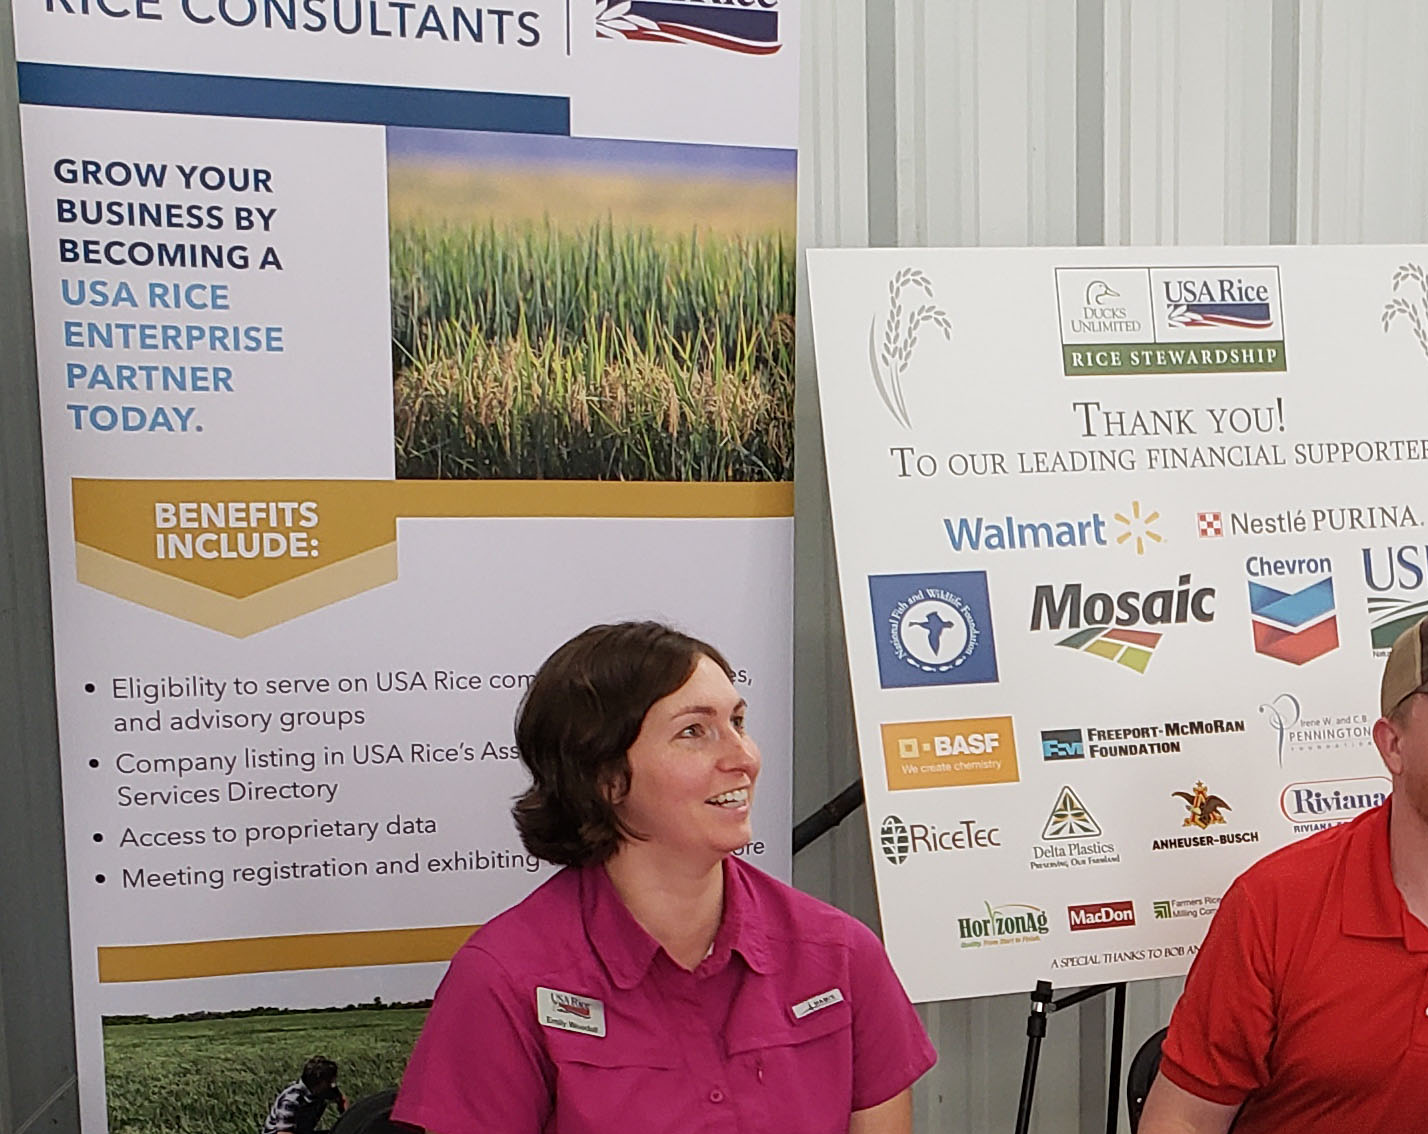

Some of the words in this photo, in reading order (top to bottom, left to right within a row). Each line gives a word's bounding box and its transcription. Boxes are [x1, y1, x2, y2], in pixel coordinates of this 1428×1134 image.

[181, 0, 541, 48] CONSULTANTS
[53, 158, 168, 188] GROW
[176, 164, 274, 193] YOUR
[56, 198, 224, 230] BUSINESS
[234, 206, 278, 232] BY
[59, 238, 250, 270] BECOMING
[259, 246, 284, 271] A
[61, 279, 139, 308] USA
[148, 282, 230, 310] RICE
[1163, 280, 1216, 303] USA
[1218, 279, 1270, 302] Rice
[64, 321, 284, 352] ENTERPRISE
[1071, 319, 1142, 333] UNLIMITED
[1072, 351, 1123, 368] RICE
[1130, 348, 1278, 367] STEWARDSHIP
[66, 363, 235, 392] PARTNER
[66, 404, 203, 432] TODAY.
[948, 451, 1010, 476] OUR
[1018, 447, 1138, 475] LEADING
[1147, 443, 1287, 471] FINANCIAL
[154, 500, 319, 530] BENEFITS
[1230, 508, 1307, 536] Nestlé
[155, 531, 320, 559] INCLUDE:
[943, 513, 1108, 553] Walmart
[1245, 554, 1333, 578] Chevron
[1030, 573, 1217, 632] Mosaic
[112, 677, 227, 704] Eligibility
[233, 679, 259, 696] to
[266, 679, 330, 696] serve
[337, 677, 368, 693] on
[376, 671, 427, 692] USA
[434, 670, 482, 691] Rice
[114, 710, 162, 732] and
[170, 709, 272, 733] advisory
[279, 709, 366, 732] groups
[1289, 726, 1372, 742] PENNINGTON
[933, 732, 1000, 757] BASF
[1089, 741, 1182, 759] FOUNDATION
[116, 752, 237, 778] Company
[244, 747, 316, 772] listing
[323, 746, 345, 766] in
[353, 744, 404, 765] USA
[902, 763, 919, 775] We
[920, 762, 952, 774] create
[117, 786, 220, 806] Services
[228, 781, 339, 803] Directory
[1291, 788, 1386, 815] Riviana
[120, 827, 206, 848] Access
[211, 825, 237, 843] to
[245, 818, 379, 847] proprietary
[386, 814, 437, 836] data
[910, 820, 1002, 853] RiceTec
[1152, 831, 1260, 851] ANHEUSER-BUSCH
[1033, 845, 1067, 859] Delta
[1068, 841, 1115, 857] Plastics
[122, 865, 225, 889] Meeting
[232, 858, 368, 886] registration
[375, 853, 419, 875] and
[427, 849, 540, 873] exhibiting
[1070, 907, 1134, 927] MacDon
[1051, 958, 1059, 969] A
[1060, 955, 1100, 968] SPECIAL
[1103, 950, 1146, 964] THANKS
[1149, 948, 1163, 959] TO
[1186, 944, 1201, 955] AN
